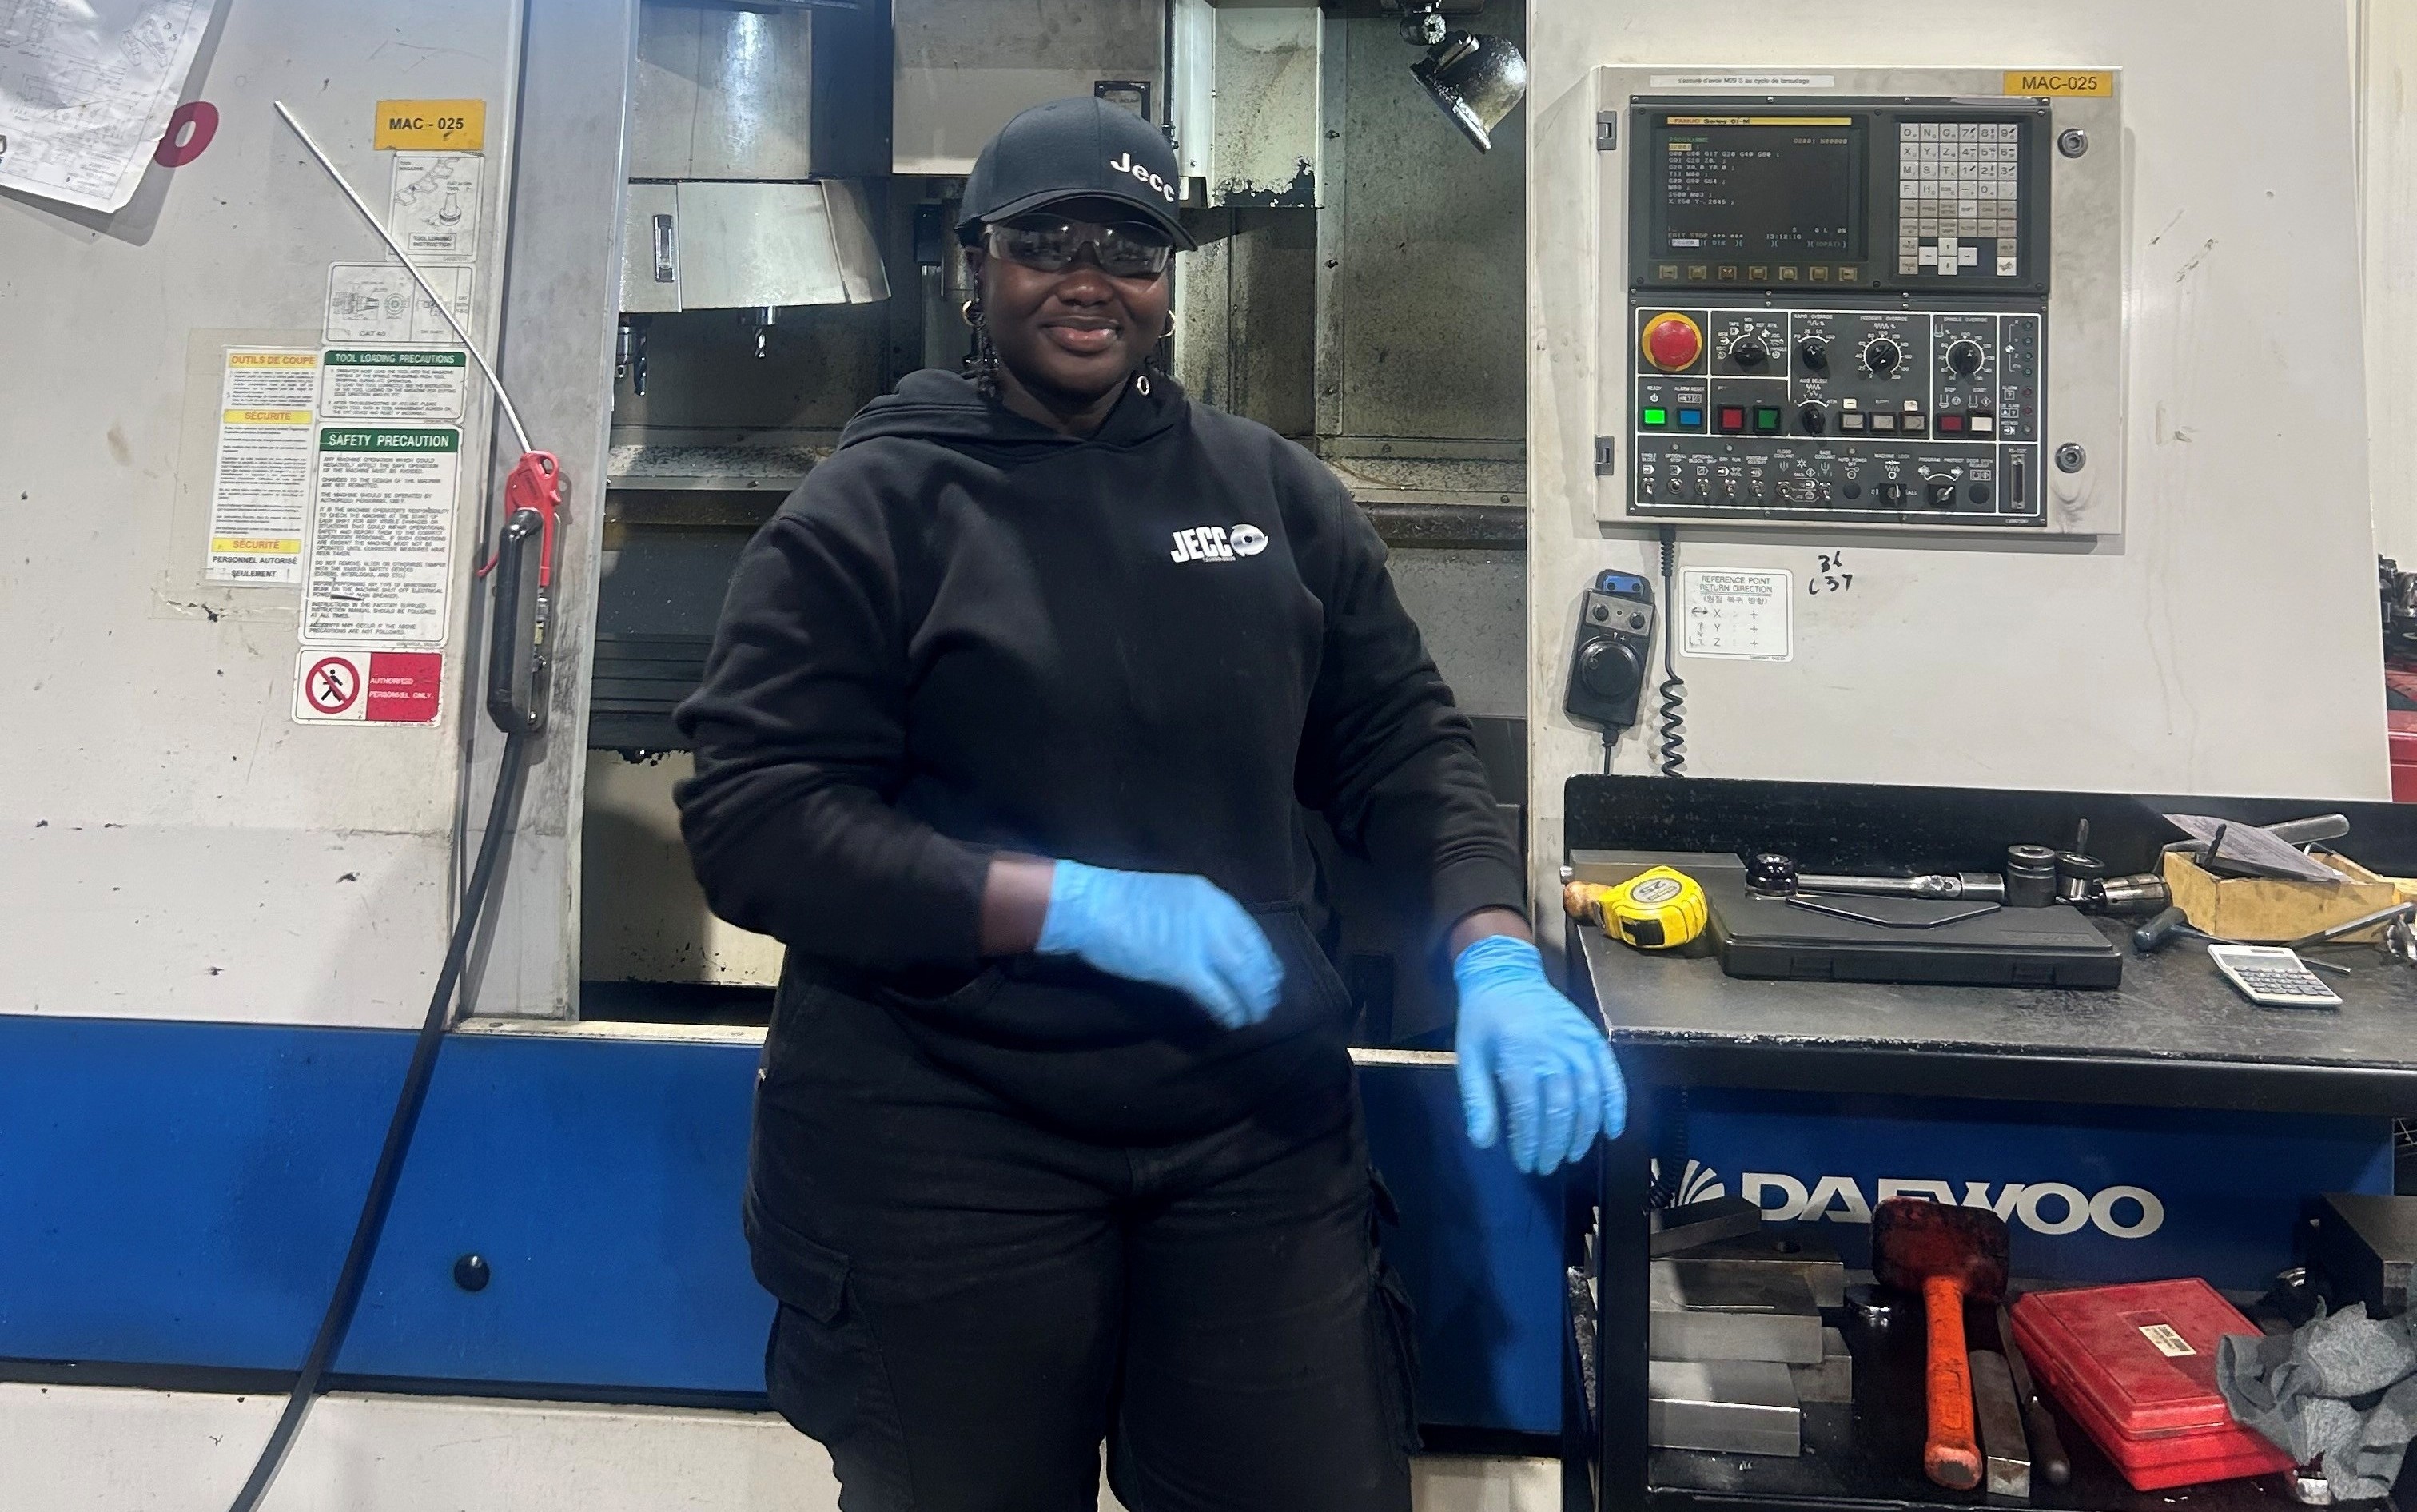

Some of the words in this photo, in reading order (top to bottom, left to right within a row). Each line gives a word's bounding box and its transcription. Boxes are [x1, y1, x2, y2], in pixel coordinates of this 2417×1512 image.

[2022, 76, 2097, 90] MAC-025
[389, 117, 424, 129] MAC
[438, 117, 464, 129] 025
[1110, 153, 1175, 203] Jecc
[336, 353, 357, 362] TOOL
[360, 354, 396, 363] LOADING
[400, 354, 455, 364] PRECAUTIONS
[245, 411, 291, 420] SÉCURITÉ
[329, 434, 372, 446] SAFETY
[377, 435, 448, 447] PRECAUTION
[233, 539, 280, 549] SÉCURITÉ
[1170, 526, 1234, 563] JECC
[1702, 575, 1745, 584] REFERENCE
[1748, 576, 1770, 585] POINT
[1714, 609, 1721, 618] X
[1714, 623, 1721, 632] Y
[1714, 638, 1721, 647] Z
[1639, 881, 1666, 893] 25
